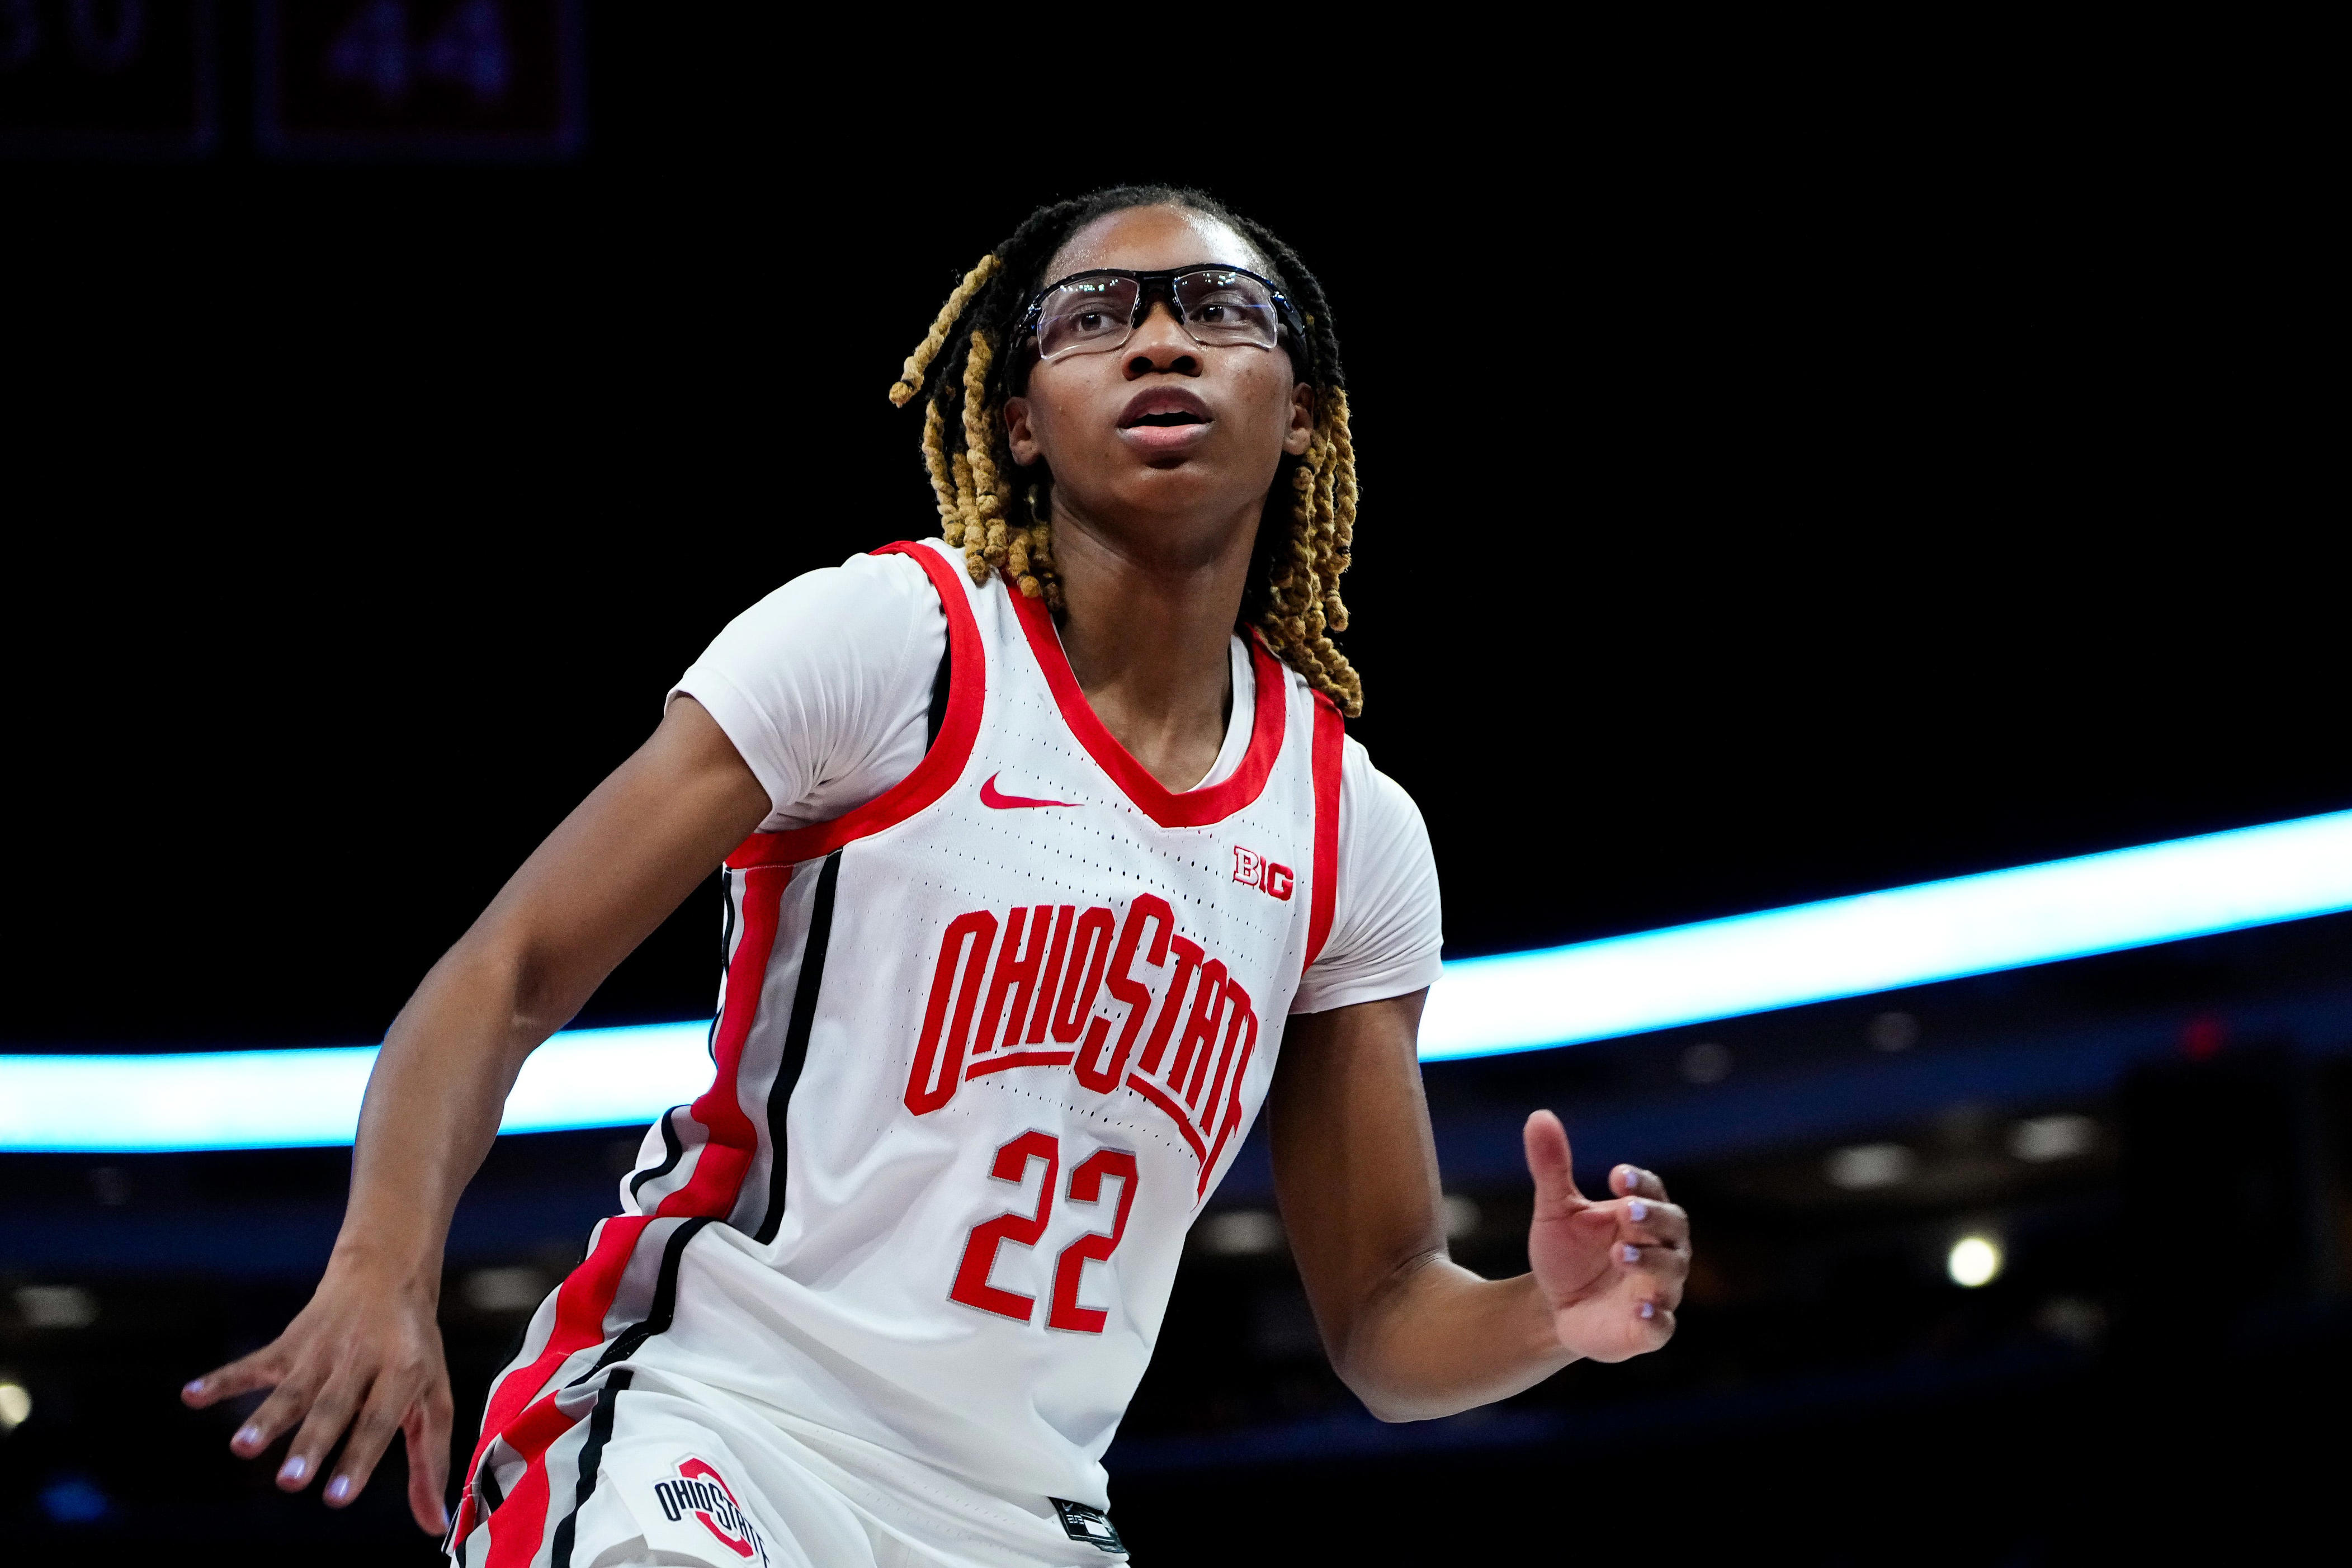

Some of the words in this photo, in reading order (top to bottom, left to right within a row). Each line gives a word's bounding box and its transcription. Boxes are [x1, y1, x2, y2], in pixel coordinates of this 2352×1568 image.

[904, 905, 1116, 1116] OHIO
[946, 1127, 1139, 1335] 22
[654, 1480, 714, 1522] OHIO
